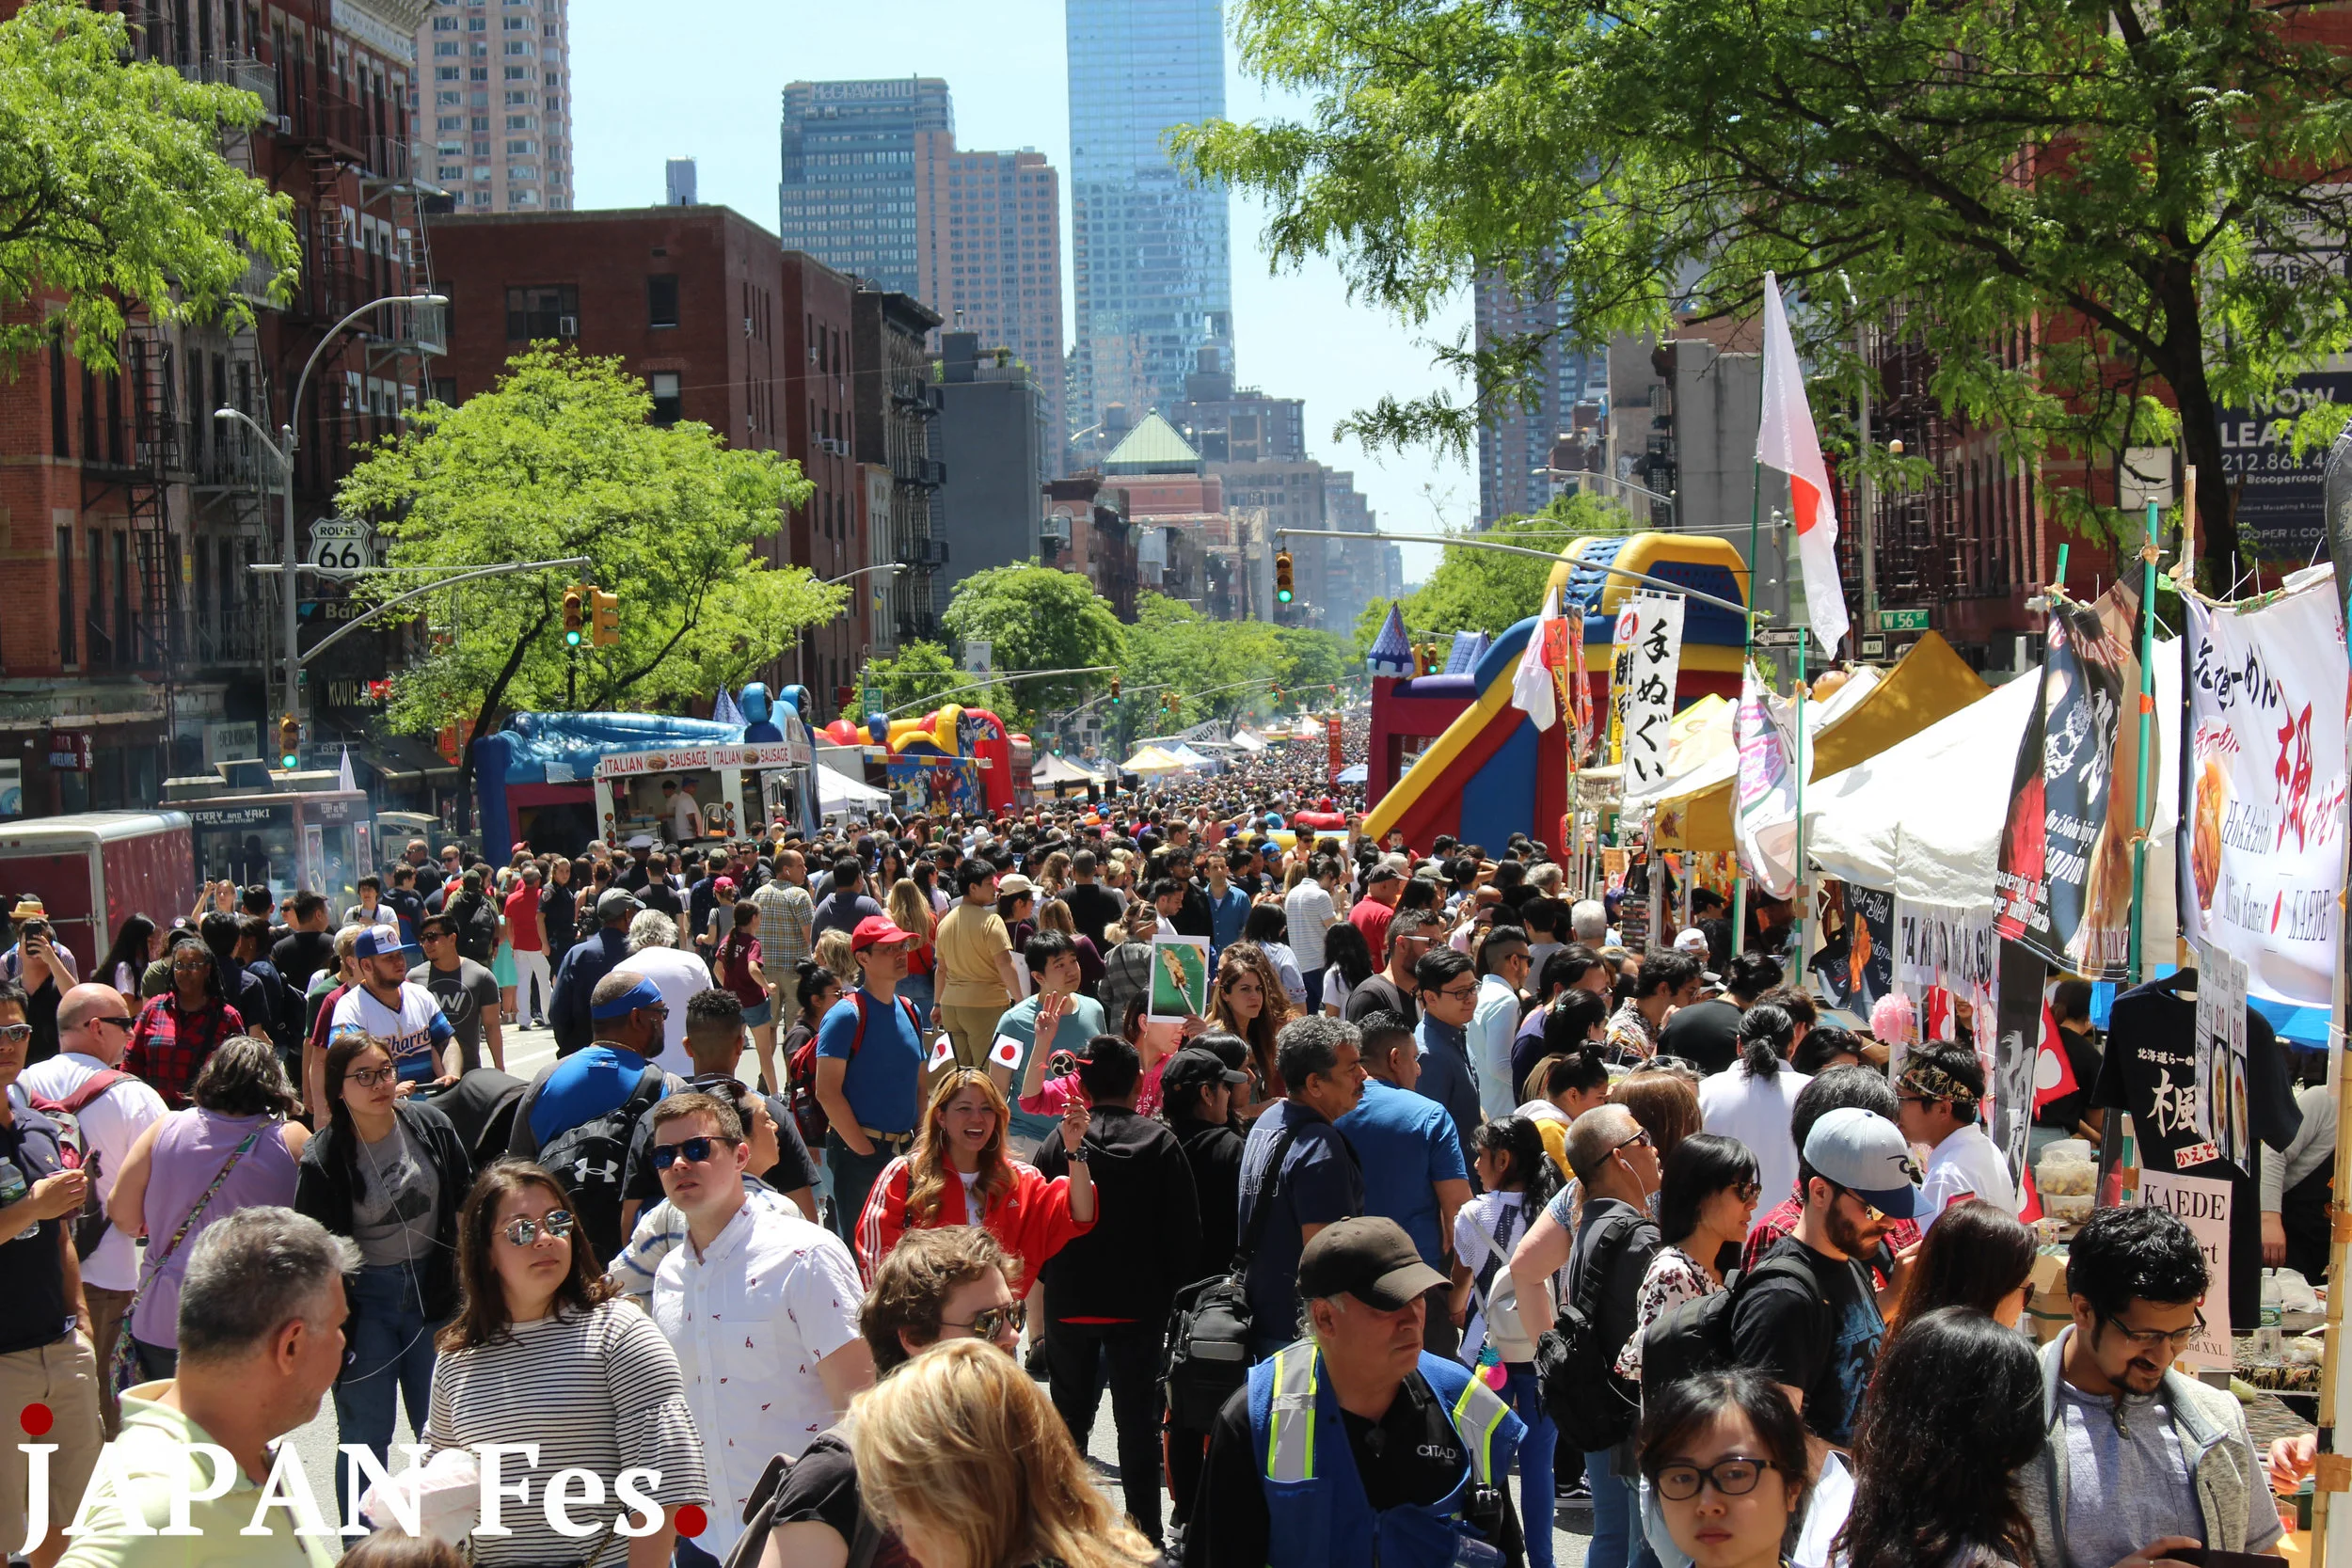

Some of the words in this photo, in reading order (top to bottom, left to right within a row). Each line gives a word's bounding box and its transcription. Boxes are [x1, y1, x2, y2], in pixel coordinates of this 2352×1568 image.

[320, 527, 358, 536] ROUTE
[318, 541, 360, 569] 66
[1883, 616, 1894, 628] W
[1898, 614, 1915, 628] 56
[1916, 611, 1926, 622] ST
[1758, 633, 1778, 642] ONE
[1788, 632, 1806, 641] WA
[1633, 617, 1671, 782] 手ぬぐい
[605, 756, 644, 774] ITALIAN
[669, 750, 707, 768] SAUSAGE
[713, 751, 741, 765] ITALIAN
[760, 747, 788, 762] SAUSAGE
[190, 811, 223, 821] TERRY
[245, 808, 271, 818] YAKI
[2221, 800, 2272, 855] Hokkaido
[2242, 882, 2268, 934] Ramen
[2216, 1003, 2225, 1035] $10
[2233, 1017, 2243, 1049] $10
[2176, 1143, 2217, 1166] かえで
[2143, 1183, 2226, 1222] KAEDE
